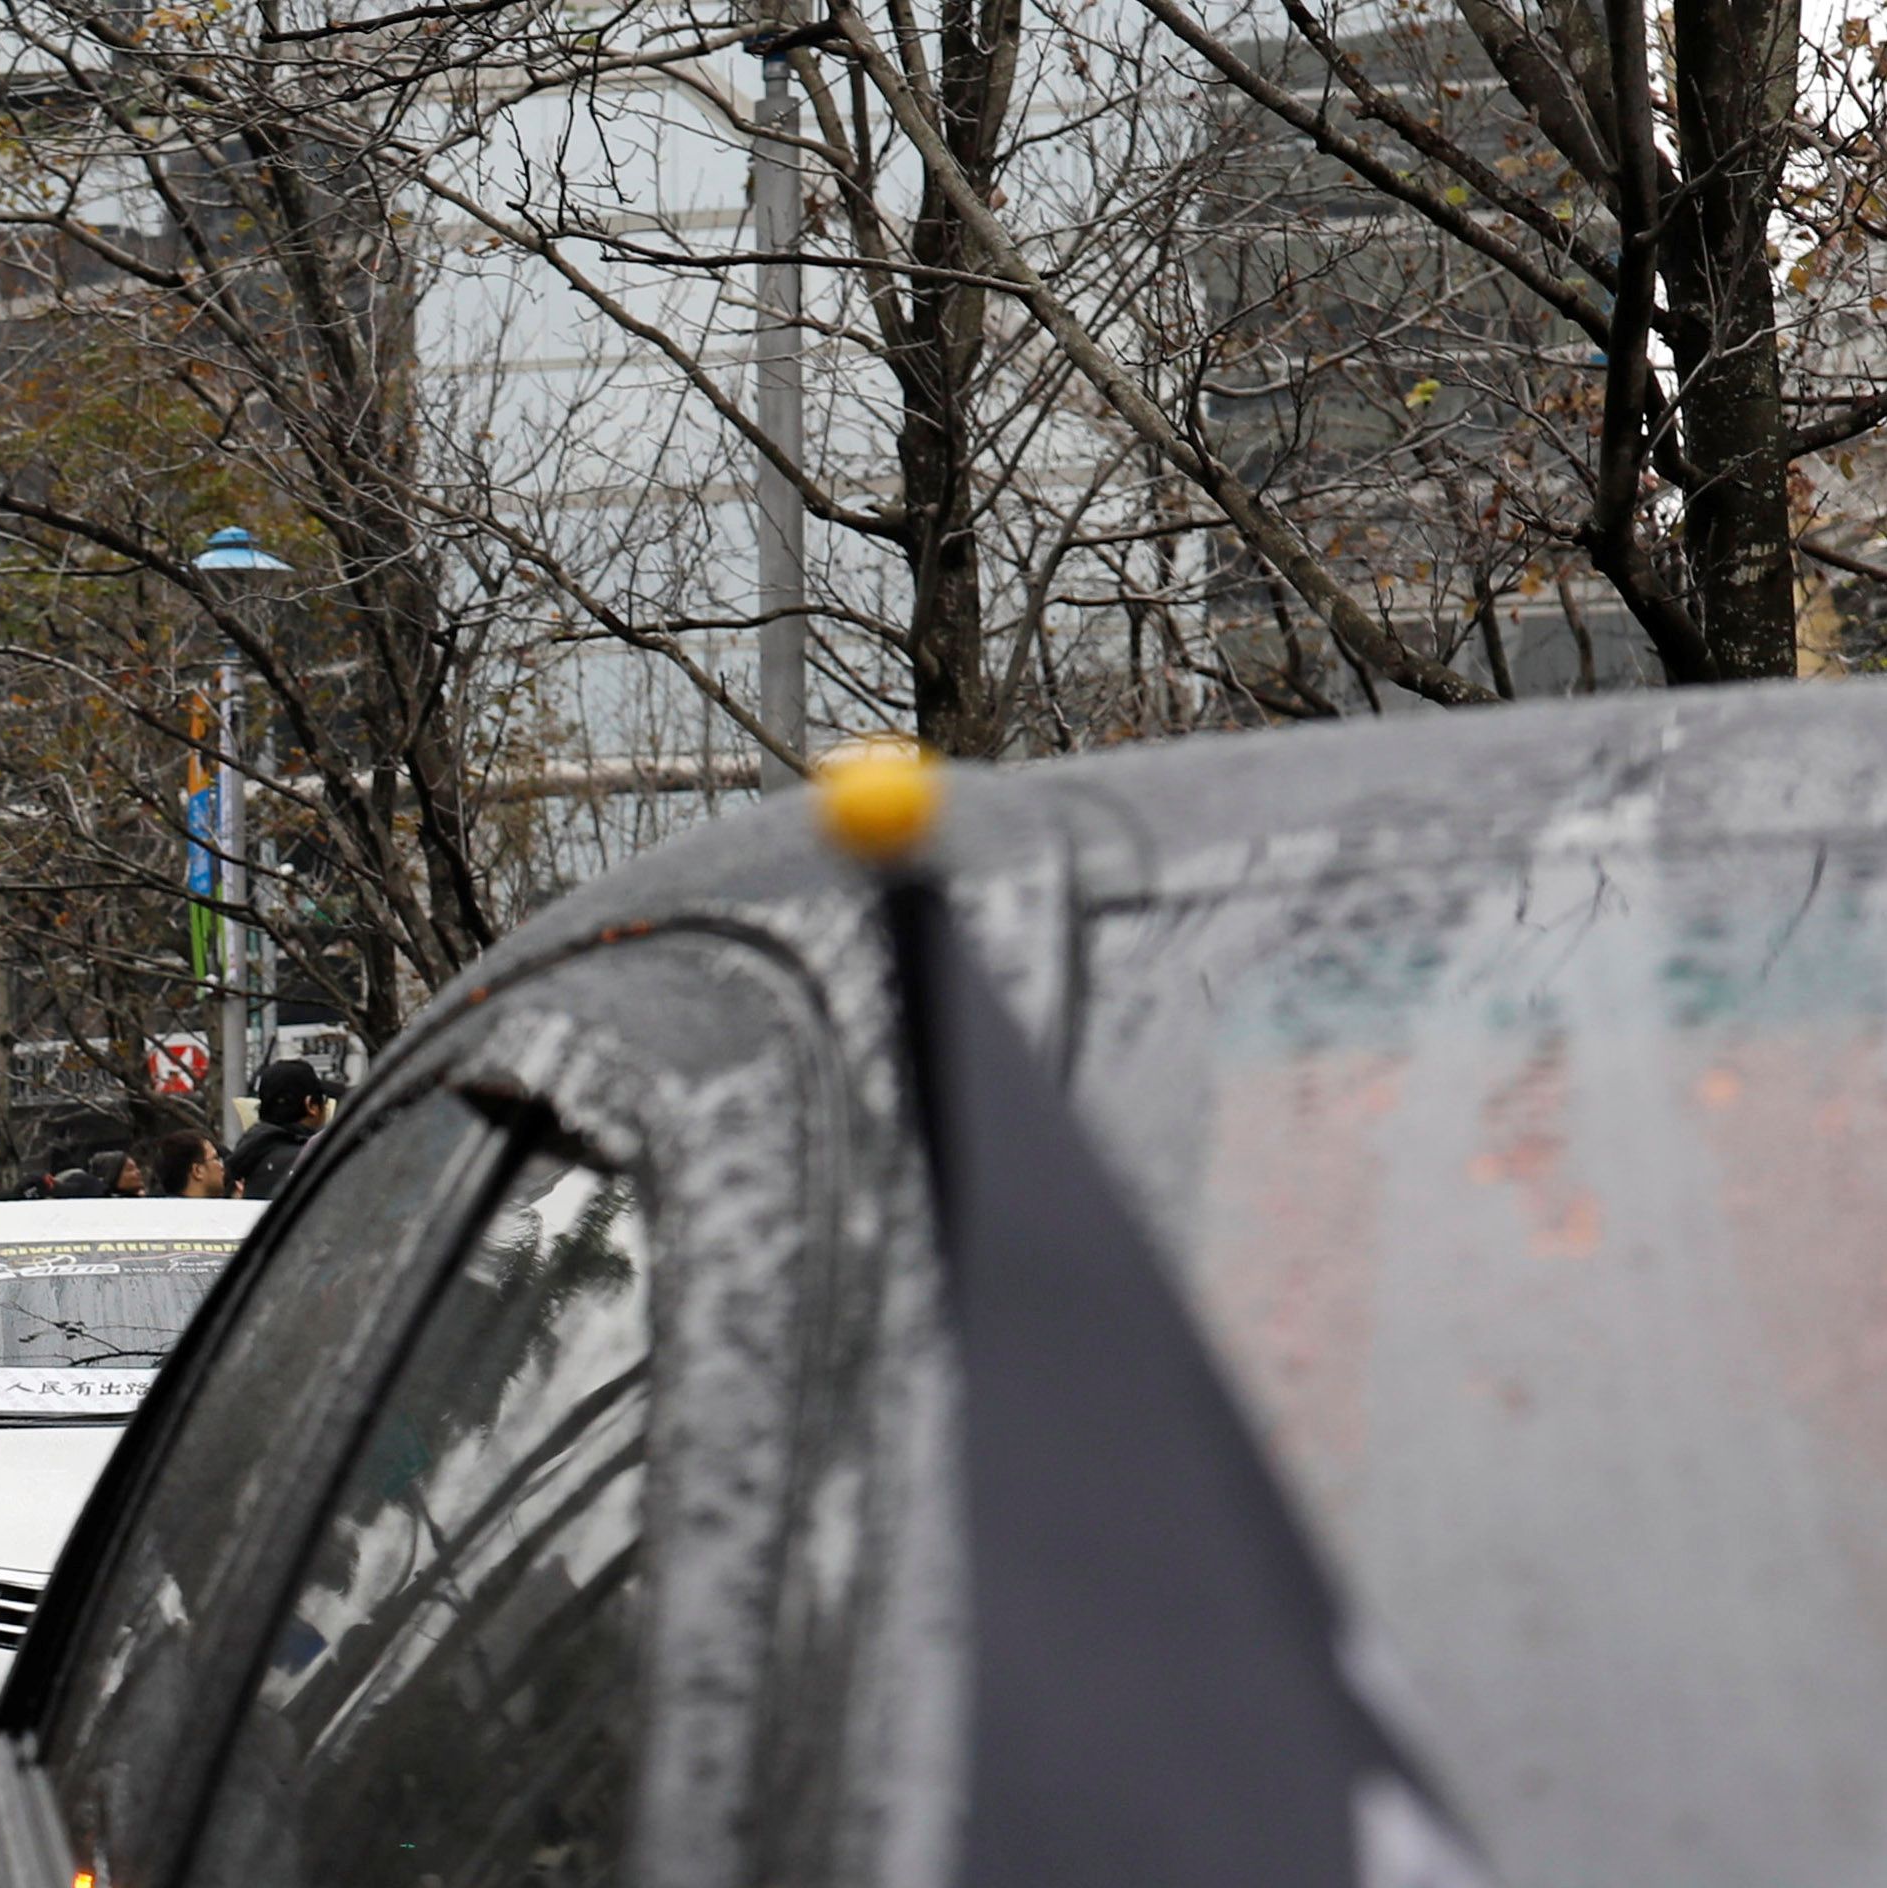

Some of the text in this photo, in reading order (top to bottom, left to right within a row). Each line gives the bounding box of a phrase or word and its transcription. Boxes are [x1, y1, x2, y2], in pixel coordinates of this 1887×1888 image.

[5, 1381, 151, 1397] 人民有出路
